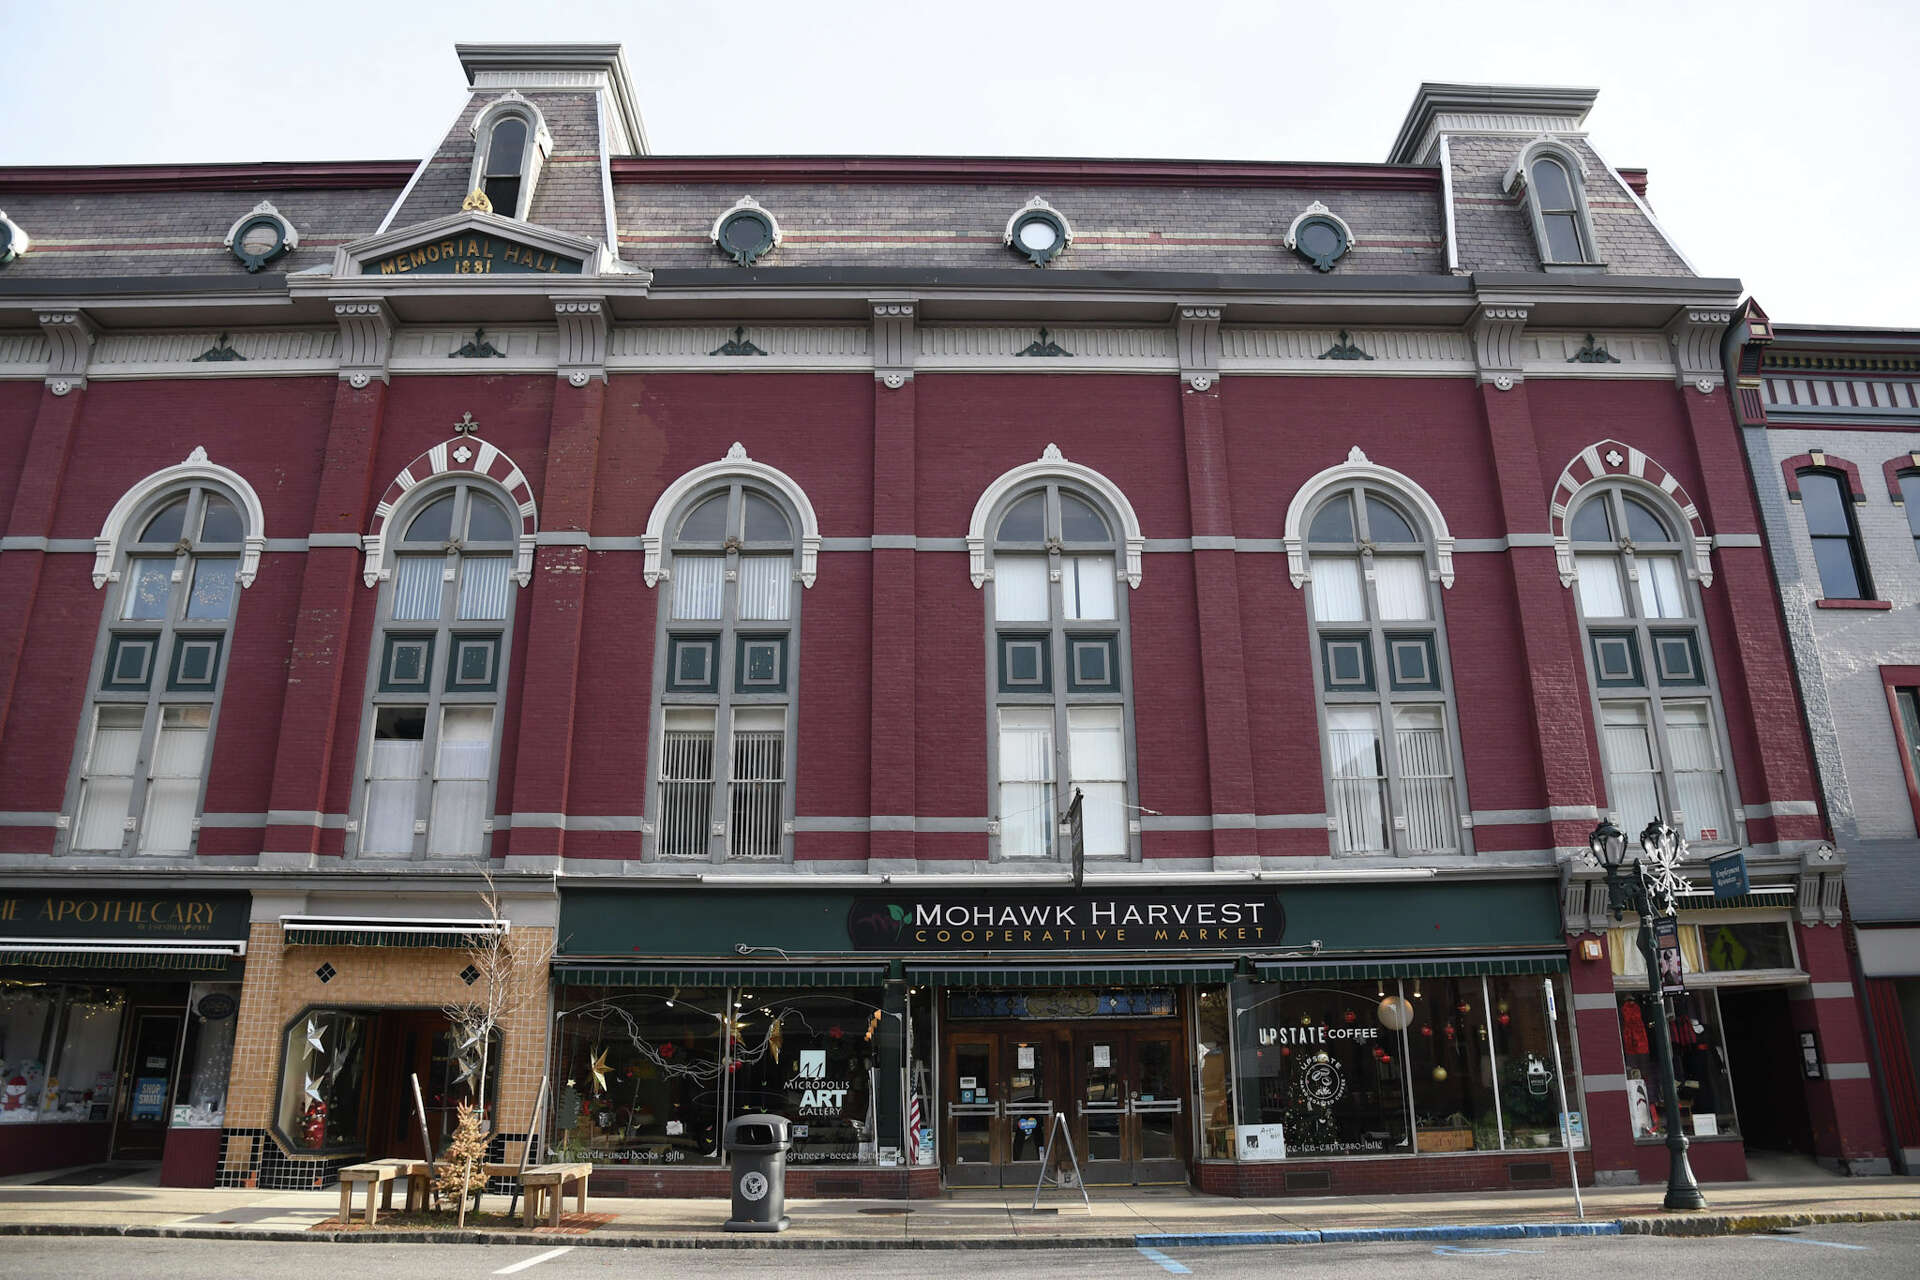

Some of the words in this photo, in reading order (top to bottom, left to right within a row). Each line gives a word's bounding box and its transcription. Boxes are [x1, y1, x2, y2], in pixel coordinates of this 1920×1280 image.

[380, 239, 495, 275] MEMORIAL
[503, 245, 561, 273] HALL
[455, 259, 492, 274] 1881
[40, 898, 217, 924] APOTHECARY
[915, 903, 1077, 926] MOHAWK
[1091, 901, 1265, 925] HARVEST
[915, 928, 1126, 943] COOPERATIVE
[1154, 927, 1264, 941] MARKET
[1258, 1026, 1327, 1045] UPSTATE
[1328, 1028, 1379, 1039] COFFEE
[783, 1080, 851, 1090] MICROPOLIS
[799, 1089, 848, 1108] ART
[798, 1107, 842, 1116] GALLERY
